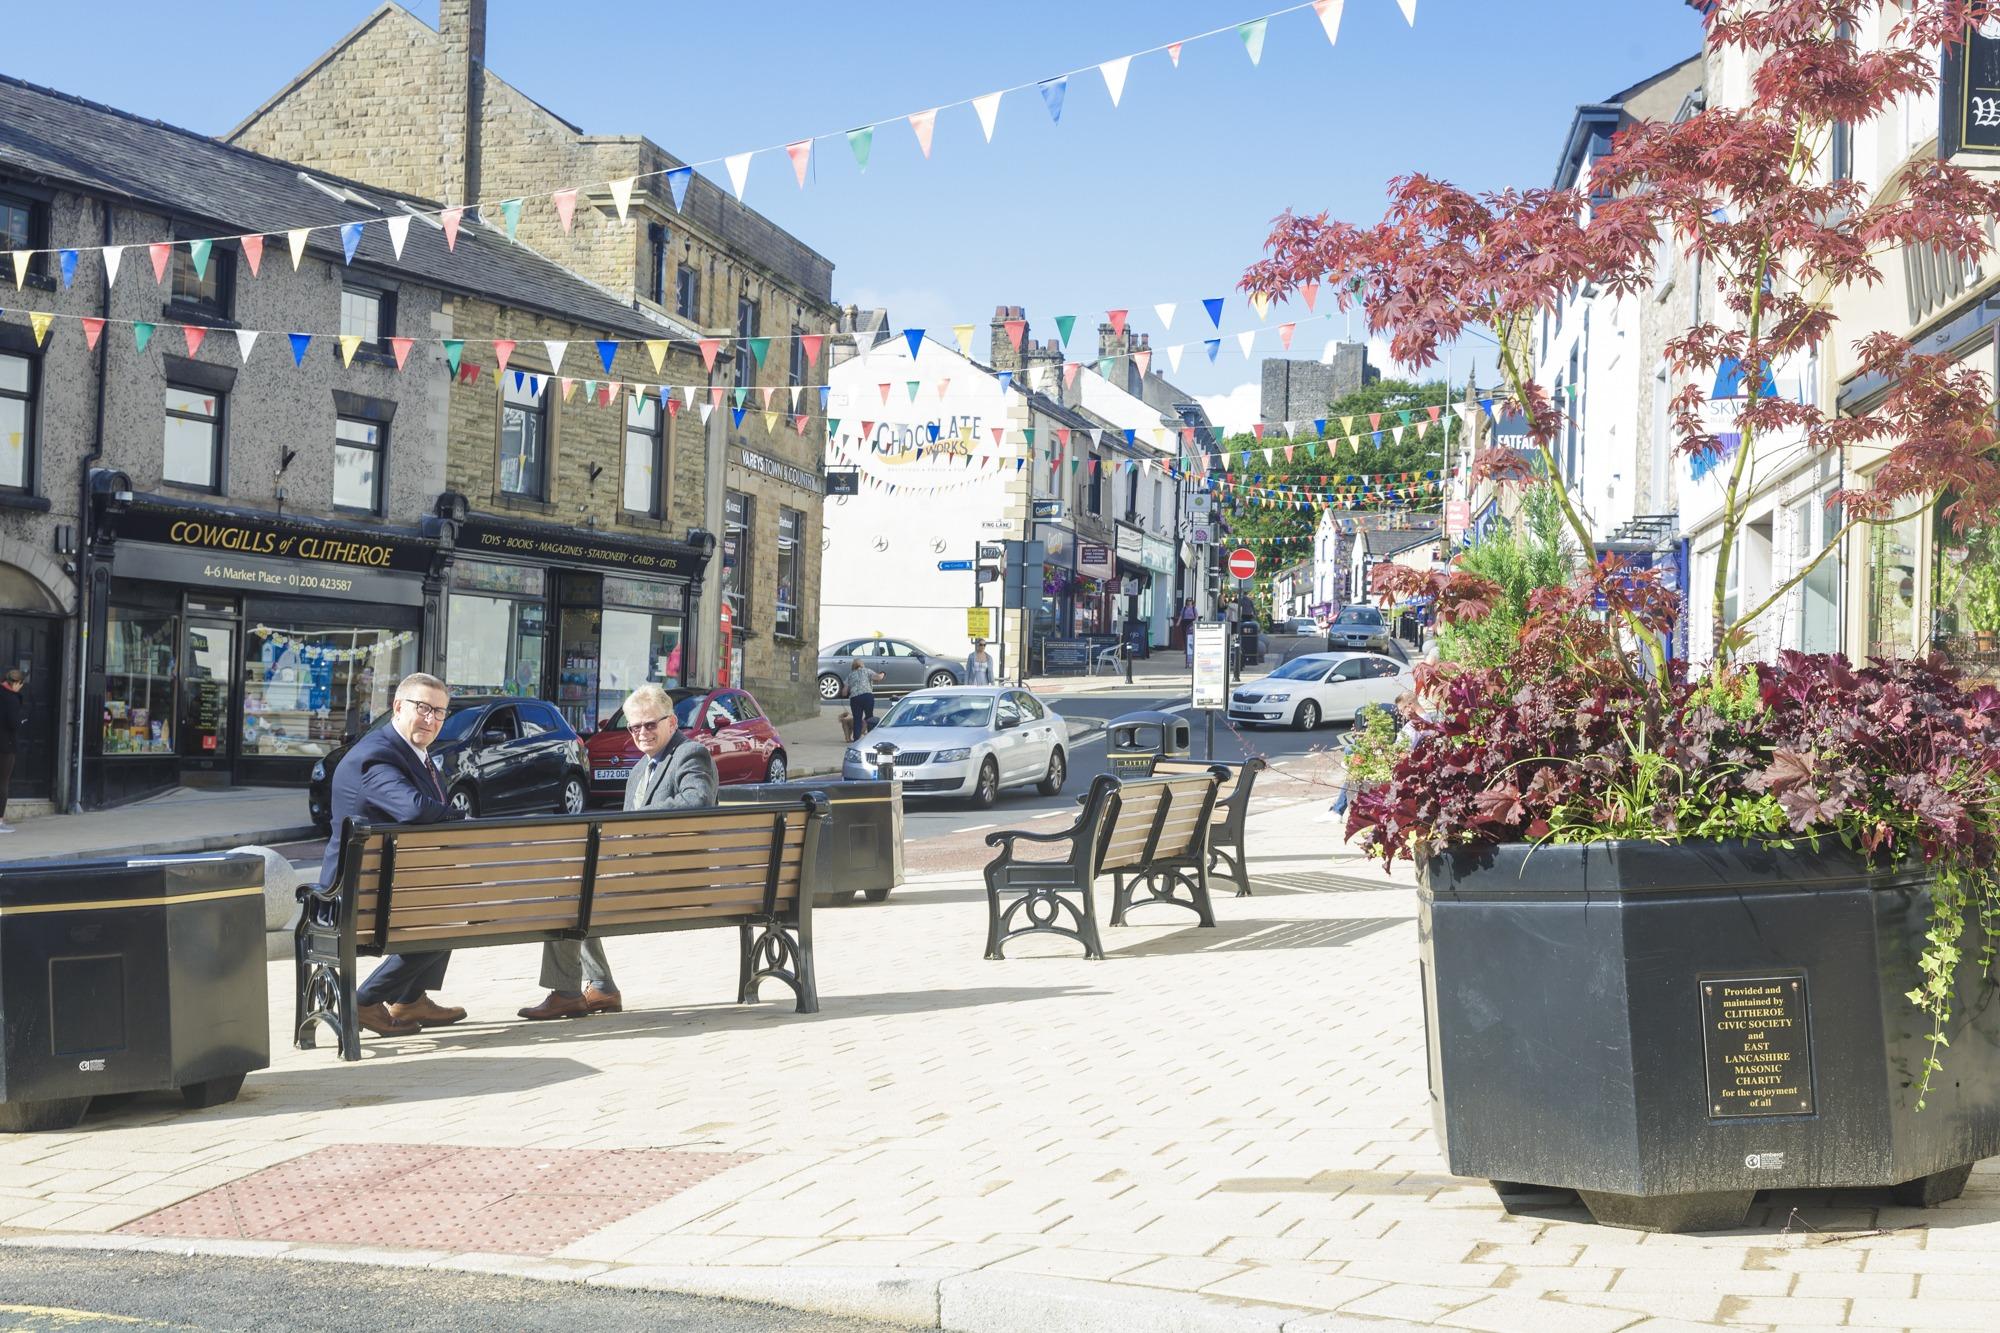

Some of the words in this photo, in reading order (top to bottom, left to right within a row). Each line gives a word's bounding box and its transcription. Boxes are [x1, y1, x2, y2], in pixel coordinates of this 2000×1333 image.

[876, 415, 982, 456] CHOCOLATE
[925, 440, 969, 456] WORKS
[1497, 434, 1542, 450] FATFAC
[741, 449, 764, 471] VAREYS
[764, 458, 783, 479] TOWN
[170, 521, 276, 553] COWGILLS
[279, 536, 297, 555] of
[299, 538, 394, 567] CLITHEROE
[481, 534, 501, 545] TOYS
[506, 537, 534, 550] BOOKS
[538, 542, 583, 556] MAGAZINES
[586, 548, 628, 562] STATIONERY
[632, 554, 656, 566] CARDS
[659, 558, 677, 569] GIFTS
[204, 565, 221, 578] 4-6
[223, 567, 256, 582] Market
[258, 571, 281, 584] Place
[289, 574, 318, 588] 01200
[319, 577, 352, 591] 423587
[1724, 986, 1763, 997] Provided
[1764, 985, 1781, 995] and
[1723, 998, 1771, 1008] maintained
[1773, 996, 1784, 1008] by
[1724, 1007, 1785, 1019] CLITHEROE
[1717, 1019, 1747, 1030] CIVIC
[1748, 1018, 1793, 1029] SOCIETY
[1748, 1031, 1764, 1040] and
[1743, 1042, 1770, 1052] EAST
[1724, 1052, 1791, 1064] LANCASHIRE
[1734, 1064, 1783, 1075] MASONIC
[1735, 1075, 1783, 1086] CHARITY
[1722, 1088, 1736, 1098] for
[1737, 1087, 1751, 1097] the
[1752, 1086, 1798, 1098] enjoyment
[1749, 1098, 1759, 1107] of
[1760, 1097, 1772, 1107] all
